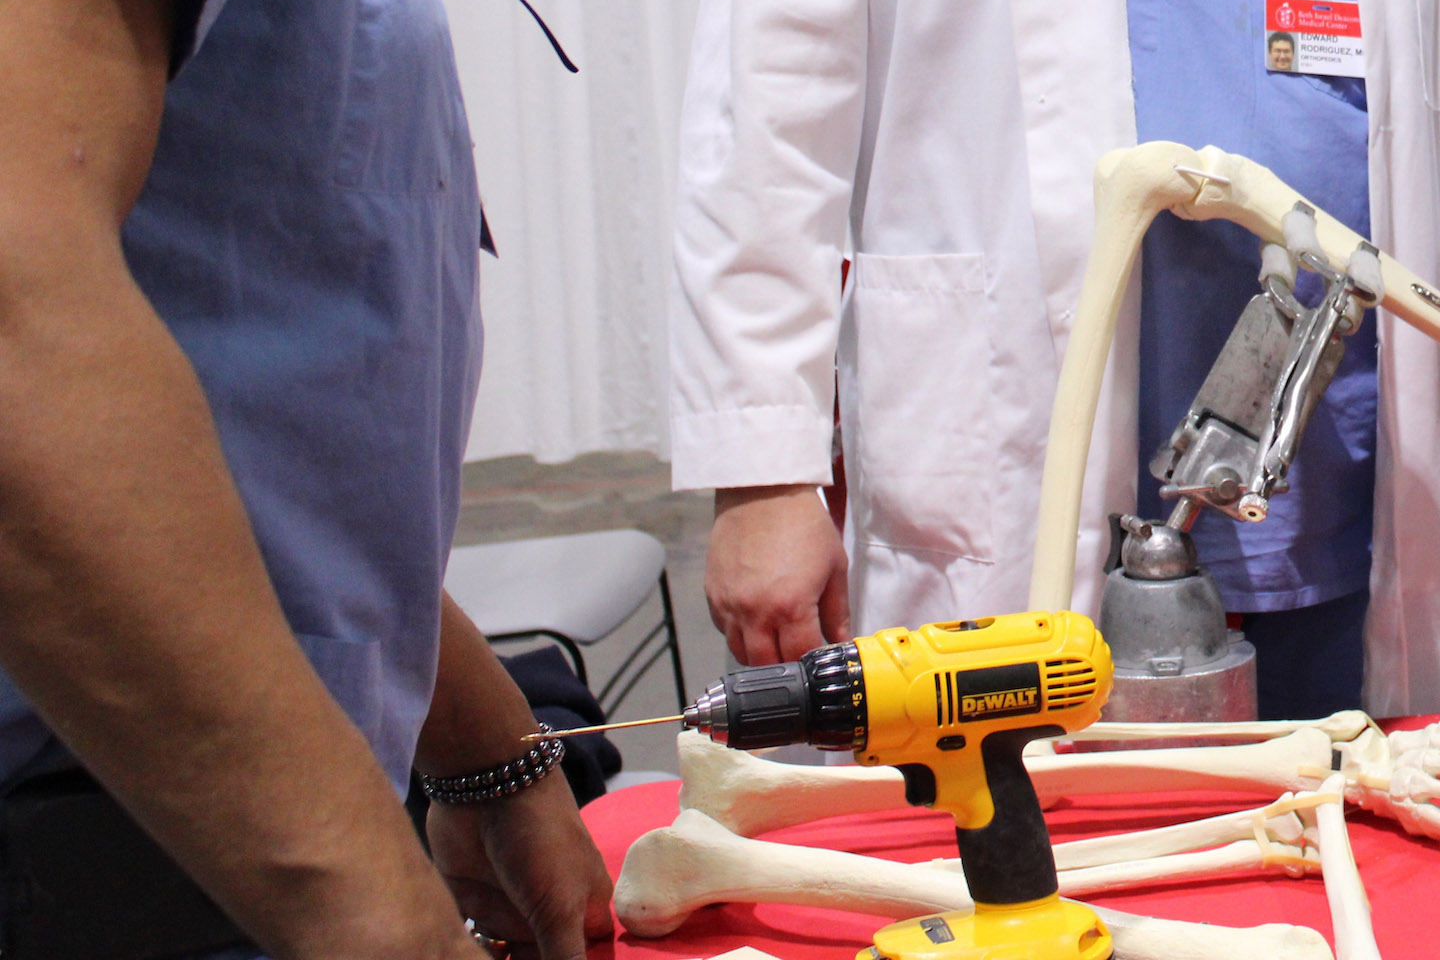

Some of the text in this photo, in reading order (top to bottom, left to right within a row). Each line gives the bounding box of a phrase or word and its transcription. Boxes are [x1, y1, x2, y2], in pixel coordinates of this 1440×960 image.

[1315, 12, 1332, 21] Israel
[1299, 18, 1348, 29] Medical Center
[1301, 33, 1338, 43] EDWARD
[1301, 44, 1353, 56] RODRIGUEZ,
[847, 660, 858, 673] 17
[852, 692, 863, 706] 15
